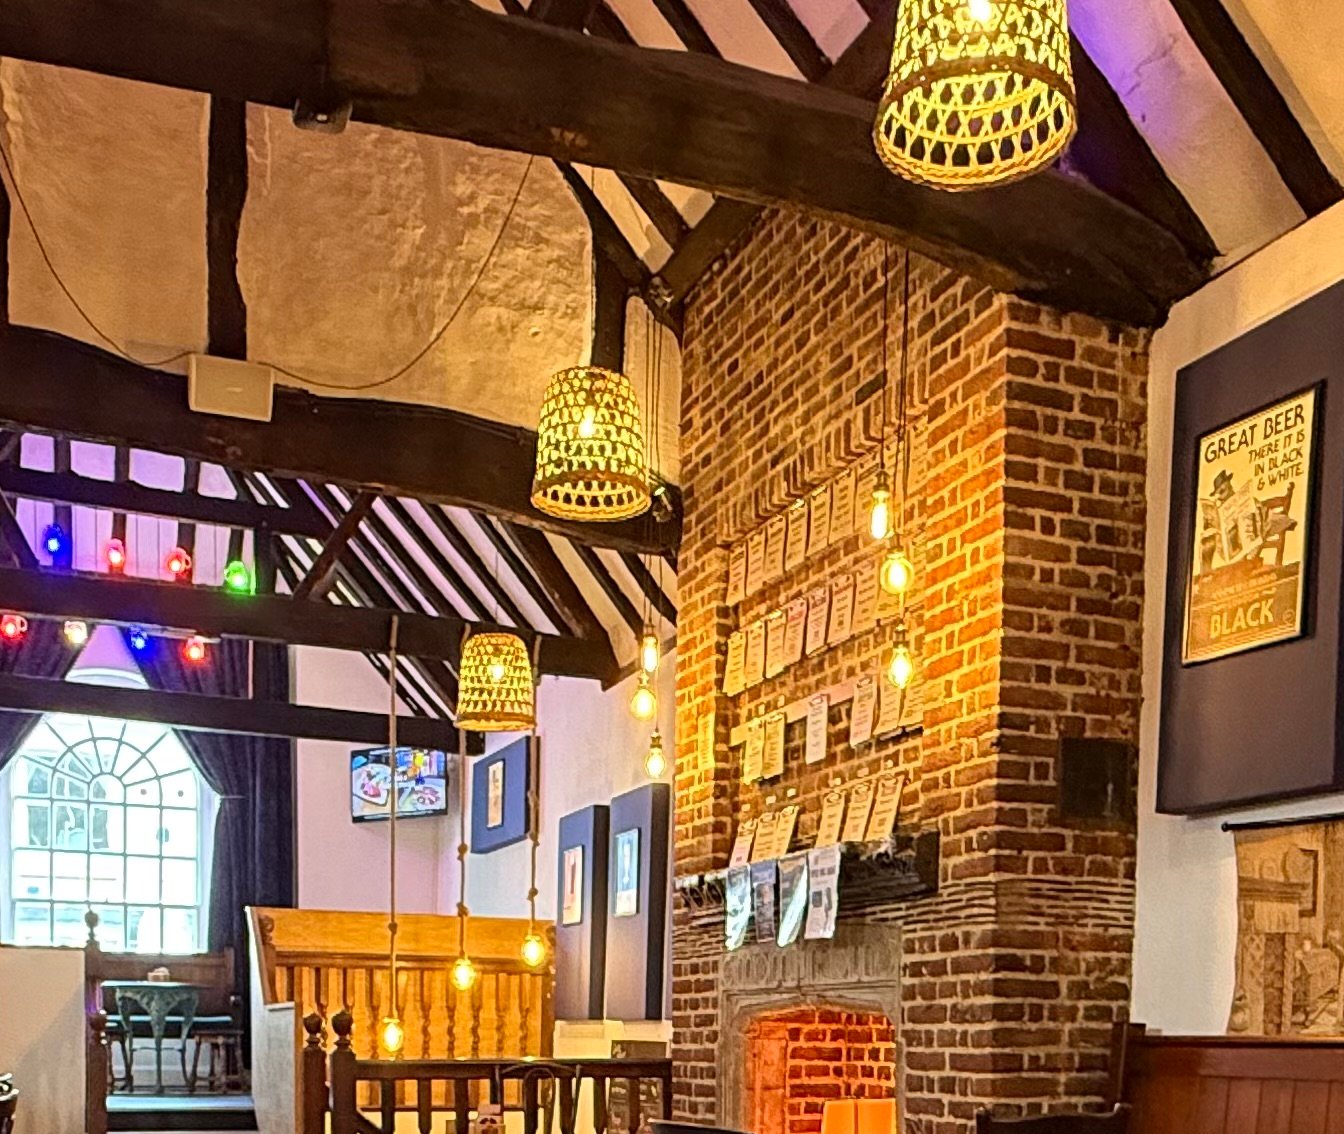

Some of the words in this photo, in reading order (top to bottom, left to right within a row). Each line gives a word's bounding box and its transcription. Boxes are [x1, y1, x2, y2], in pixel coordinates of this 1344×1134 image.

[1204, 424, 1257, 463] GREAT
[1263, 404, 1304, 440] BEER
[1248, 439, 1280, 463] THERE
[1283, 433, 1293, 449] IT
[1254, 462, 1265, 477] IN
[1268, 446, 1303, 471] BLACK
[1210, 598, 1274, 639] BLACK
